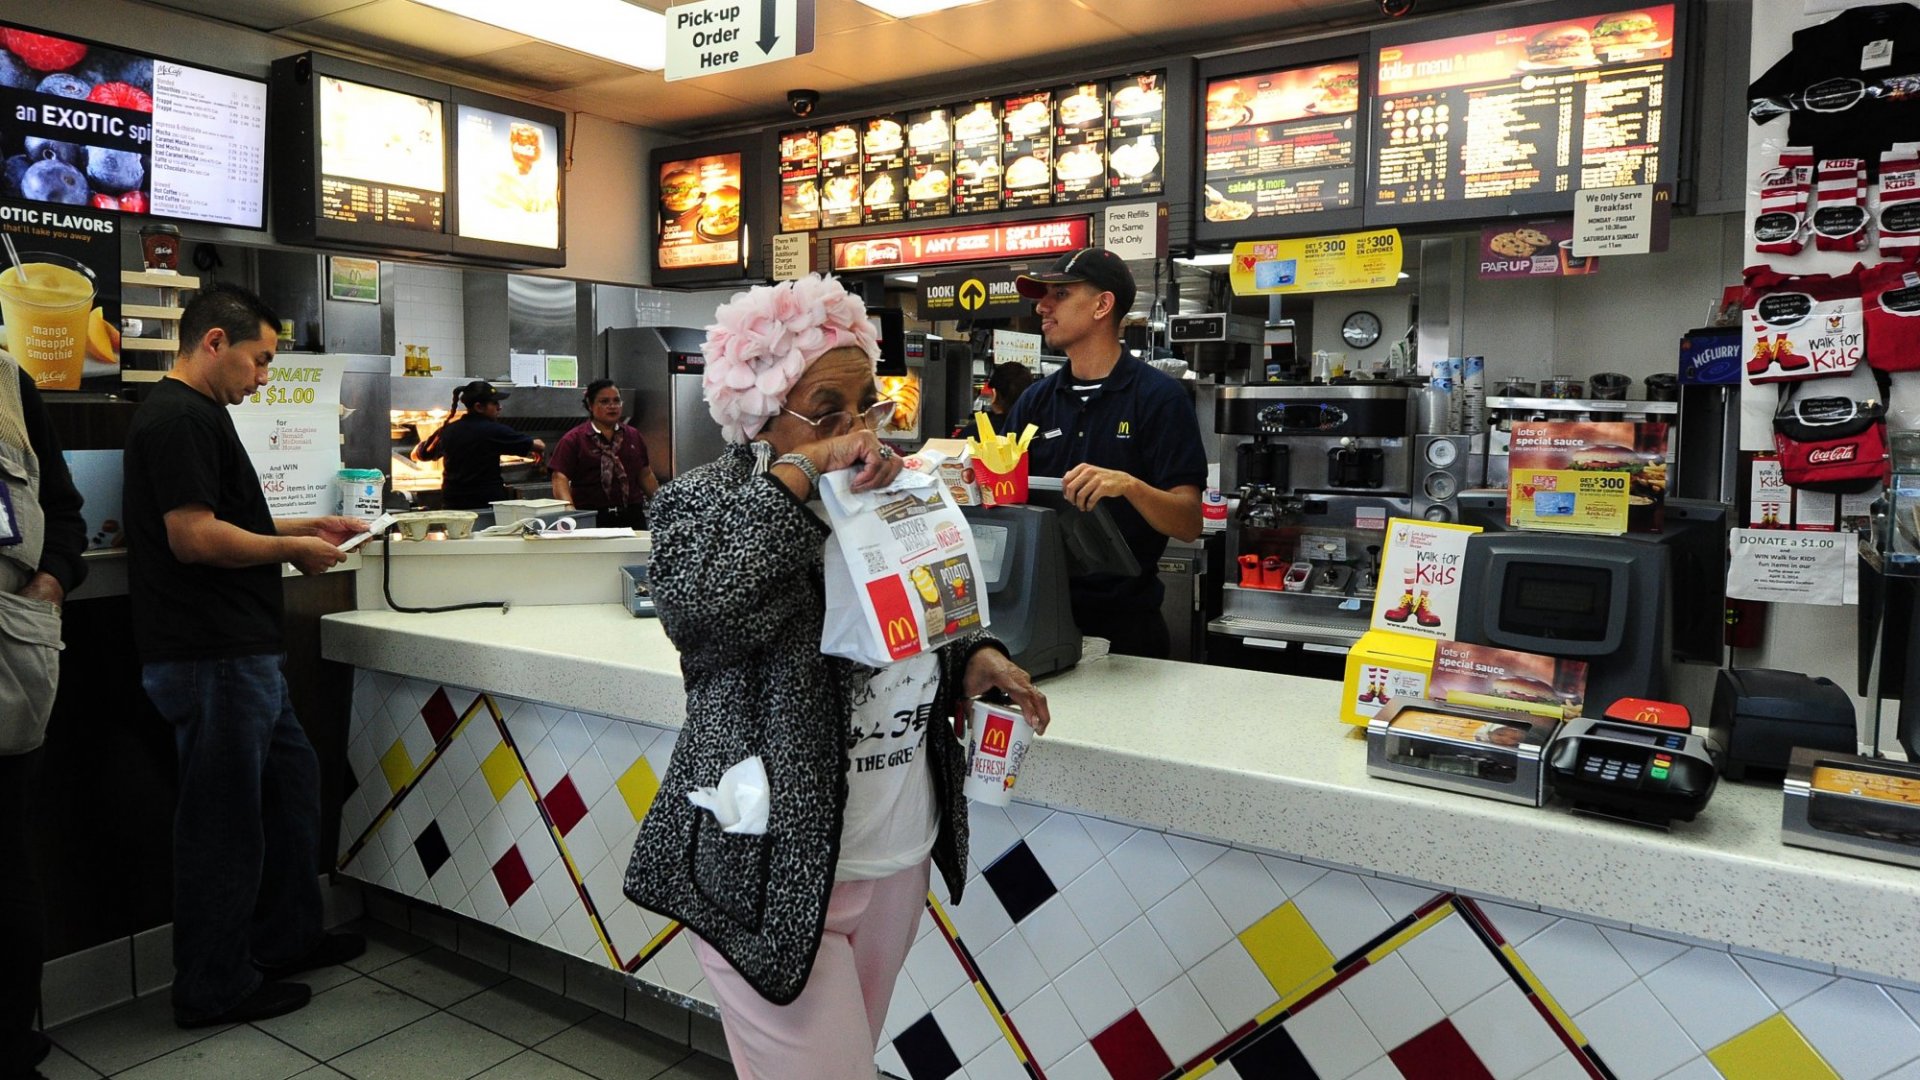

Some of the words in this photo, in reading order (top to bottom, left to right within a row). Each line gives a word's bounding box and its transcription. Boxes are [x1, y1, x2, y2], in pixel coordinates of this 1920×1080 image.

[677, 6, 740, 29] Pick-up
[692, 27, 740, 48] Order
[700, 50, 739, 68] Here
[1379, 62, 1415, 81] dollar
[1417, 58, 1452, 76] menu
[16, 105, 37, 122] an
[42, 105, 124, 137] EXOTIC
[129, 124, 152, 144] spi
[164, 164, 186, 172] Chocolate
[1825, 159, 1855, 169] KIDS
[1228, 181, 1256, 193] salads
[1257, 179, 1265, 190] &
[1266, 179, 1286, 189] more
[1885, 179, 1915, 190] KIDS
[163, 188, 177, 196] Coffee
[165, 195, 180, 203] Coffee
[1586, 195, 1599, 203] We
[1600, 194, 1618, 202] Only
[1620, 192, 1642, 200] Serve
[1594, 203, 1633, 212] Breakfast
[0, 206, 39, 223] OTIC
[42, 212, 114, 233] FLAVORS
[1110, 212, 1126, 220] Free
[1128, 210, 1150, 219] Refills
[3, 223, 30, 234] that'll
[32, 225, 51, 237] take
[53, 228, 68, 239] you
[69, 230, 92, 242] away
[1006, 225, 1037, 240] SOFT
[1109, 236, 1124, 244] Visit
[1126, 235, 1143, 244] Only
[1583, 234, 1611, 242] SATURDAY
[925, 237, 957, 254] ANY
[1051, 235, 1072, 247] TEA
[1318, 240, 1346, 252] $300
[1367, 235, 1394, 248] $300
[1366, 246, 1393, 254] CUPONES
[927, 285, 955, 298] LOOK!
[989, 281, 1018, 294] ¡MIRA
[32, 326, 67, 337] mango
[25, 336, 74, 349] pineapple
[1840, 332, 1862, 347] for
[27, 349, 72, 360] smoothie
[1811, 346, 1860, 372] Kids
[35, 370, 67, 384] McCafé
[267, 367, 323, 382] ONATE
[251, 391, 261, 403] a
[266, 385, 315, 406] $1.00
[1518, 428, 1535, 436] lots
[1537, 428, 1547, 436] of
[1516, 437, 1552, 446] special
[1809, 445, 1856, 463] Coca-Cola
[263, 481, 285, 494] Kids
[287, 484, 306, 492] items
[1594, 477, 1625, 489] $300
[1760, 476, 1784, 488] Kids
[891, 517, 928, 540] DISCOVER
[936, 526, 964, 549] INSIDE
[1740, 536, 1787, 546] DONATE
[1801, 538, 1834, 548] $1.00
[1417, 551, 1438, 562] Walk
[1442, 553, 1460, 565] for
[940, 562, 970, 586] POTATO
[1416, 563, 1456, 585] Kids
[1387, 622, 1447, 637] www.walkforkids.org
[1441, 647, 1458, 657] lots
[1460, 651, 1470, 659] of
[1439, 658, 1473, 669] special
[1475, 664, 1505, 675] sauce
[855, 754, 886, 773] THE
[888, 747, 913, 767] GRE
[975, 757, 1006, 775] REFRESH
